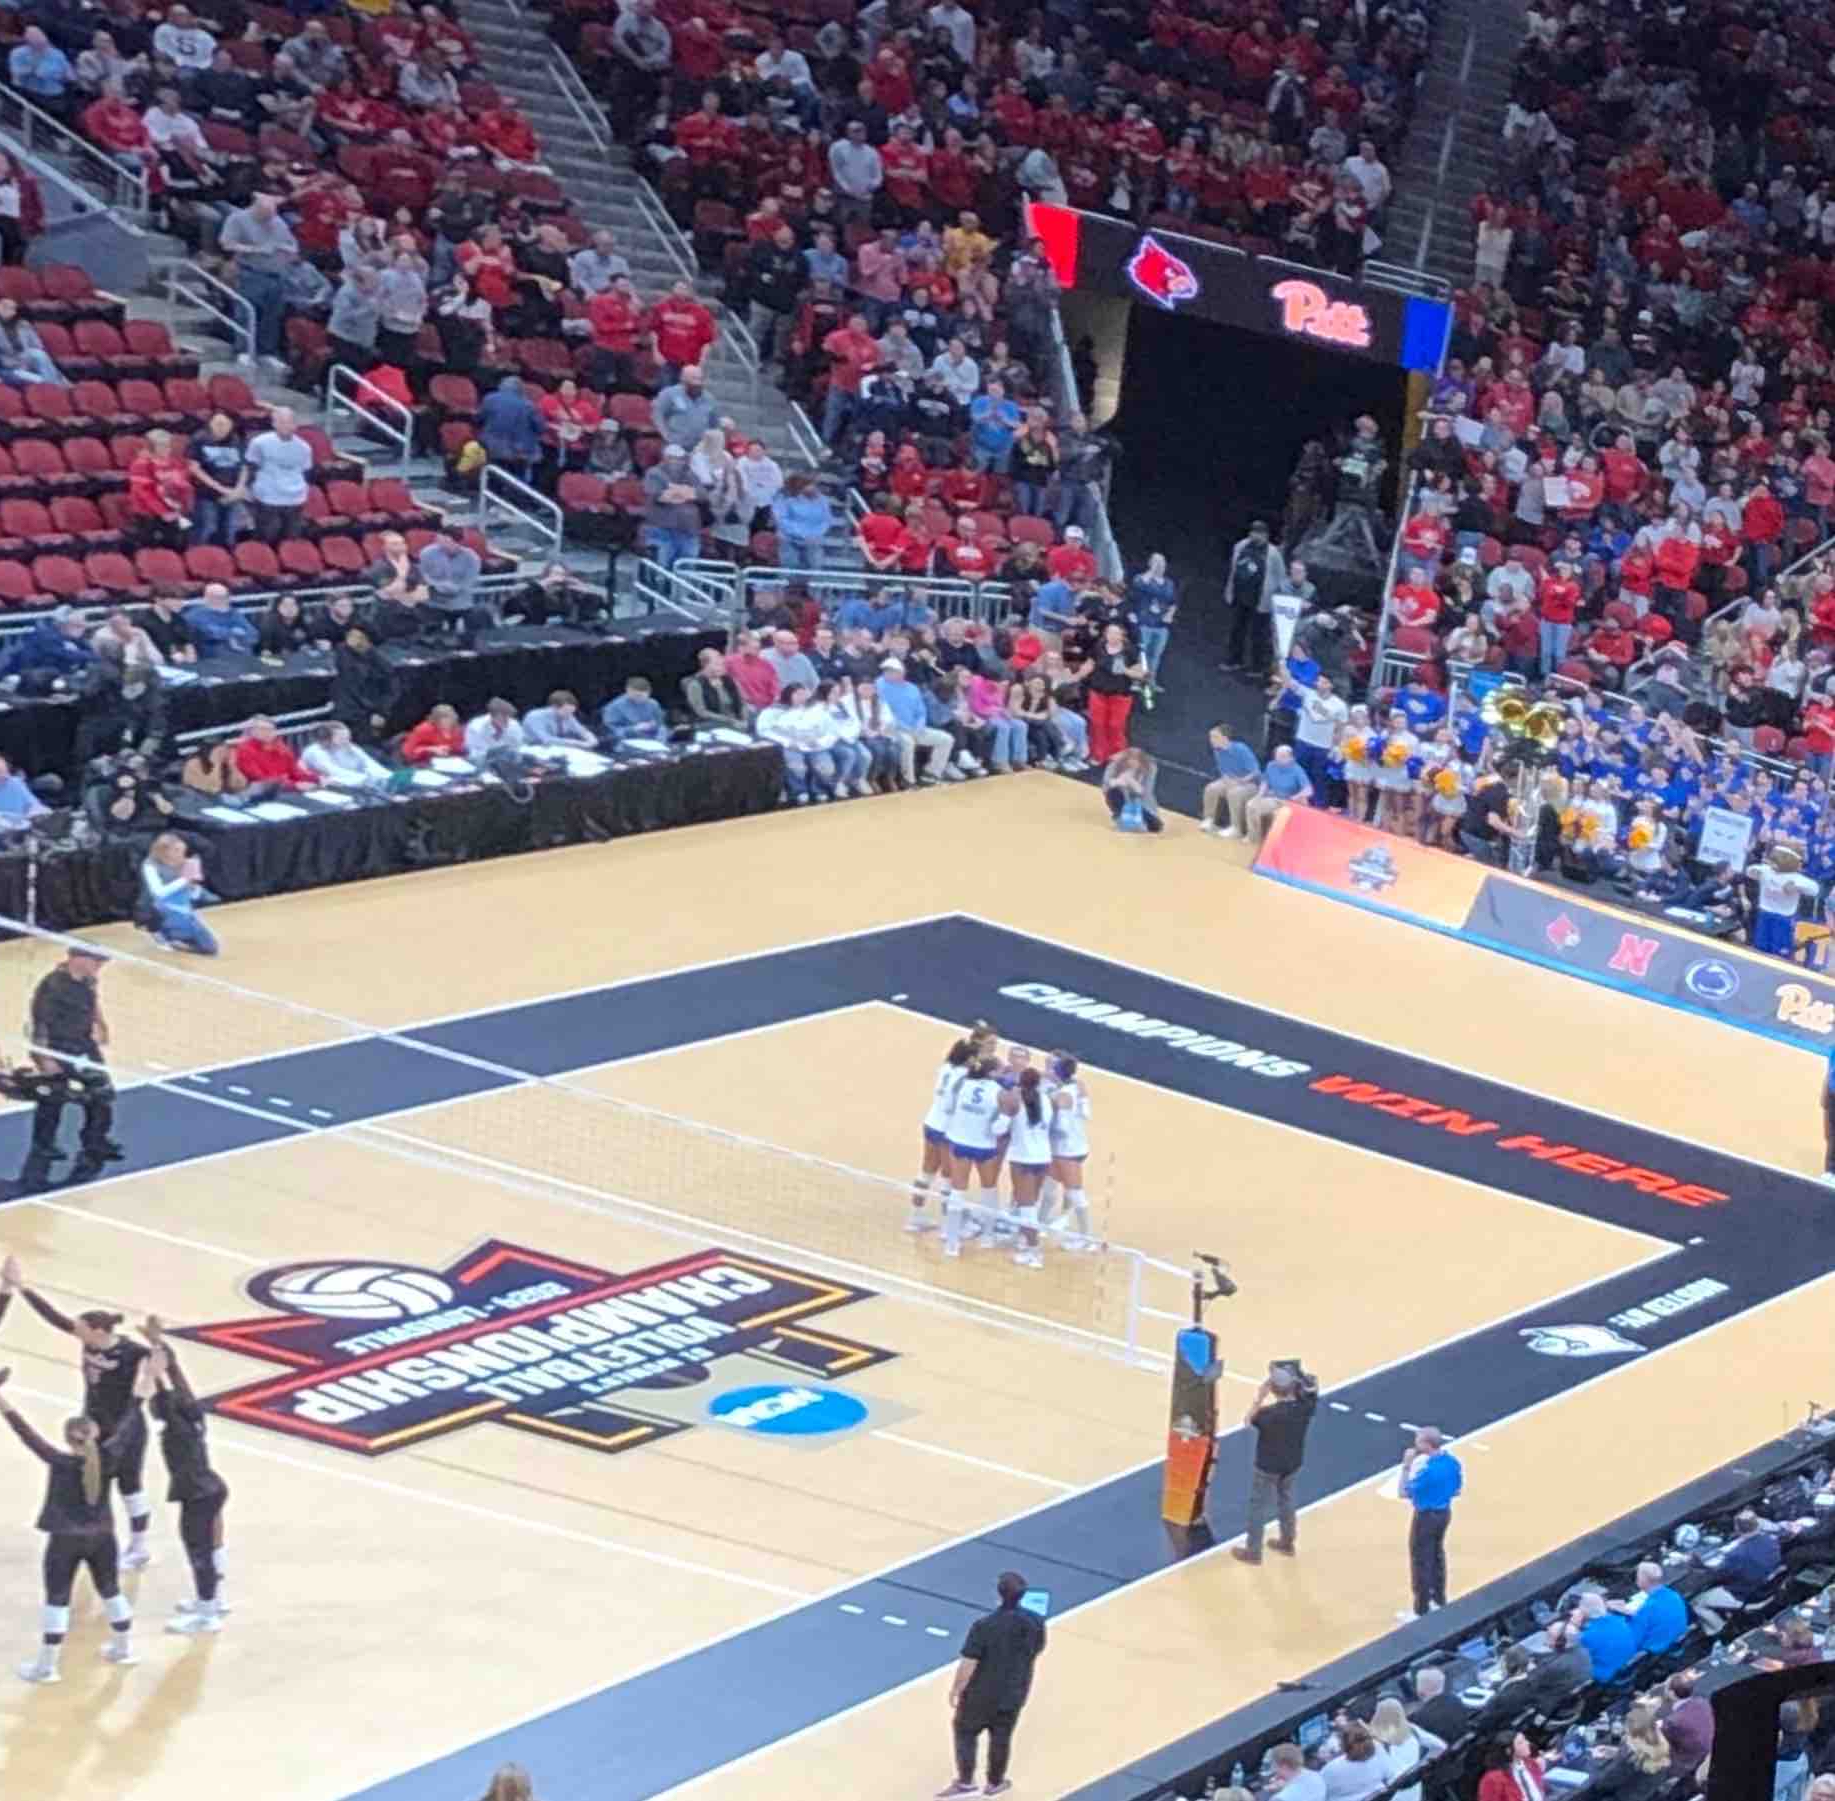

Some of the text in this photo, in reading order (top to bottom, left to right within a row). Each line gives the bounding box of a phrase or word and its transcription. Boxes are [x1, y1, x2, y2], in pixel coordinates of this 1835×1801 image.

[1271, 280, 1370, 347] Pitt
[1774, 983, 1835, 1034] Pitt
[997, 982, 1732, 1208] CHAMPIONS WIN HERE
[292, 1266, 773, 1424] CHAMPIONSHIP
[466, 1315, 738, 1402] VOLLEYBALL
[714, 1386, 825, 1427] NCAA
